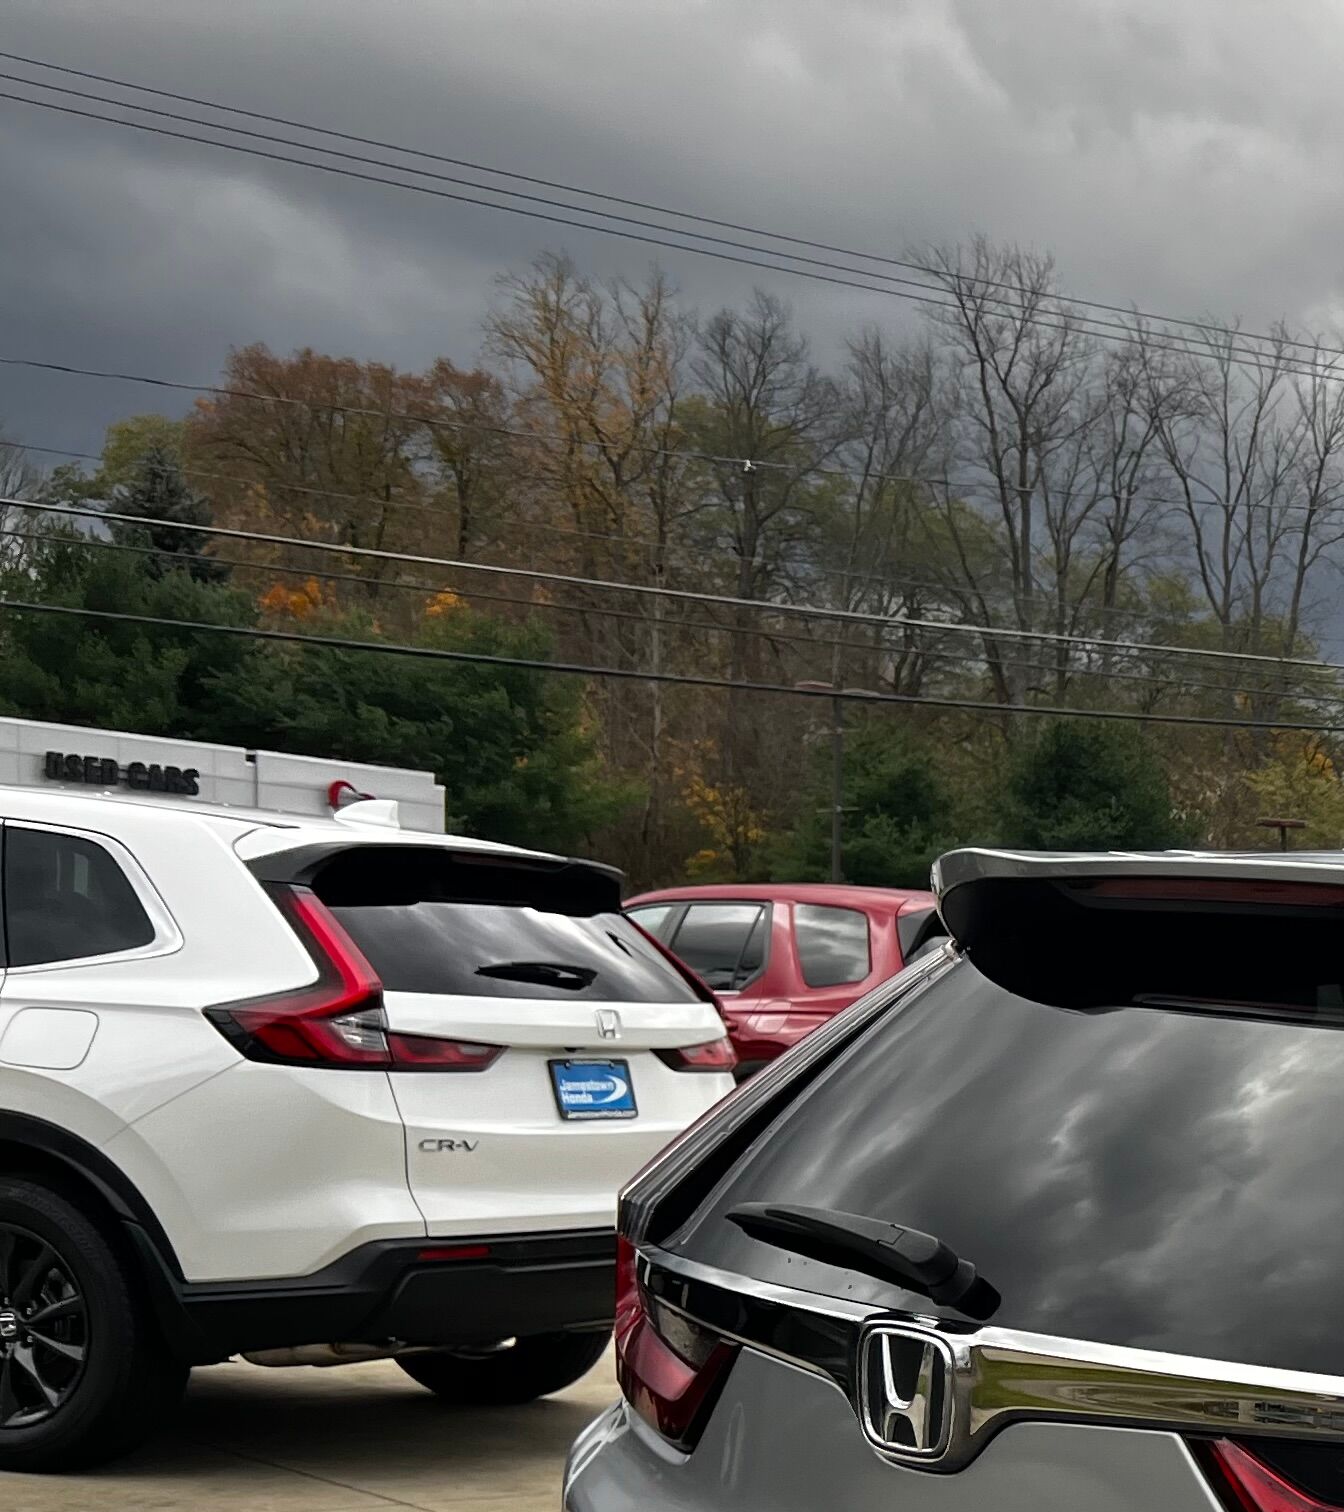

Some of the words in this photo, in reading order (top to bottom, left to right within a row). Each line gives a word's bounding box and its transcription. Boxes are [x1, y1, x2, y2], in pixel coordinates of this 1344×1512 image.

[45, 751, 120, 785] USED
[127, 762, 200, 796] CARS
[418, 1138, 479, 1152] CR-V
